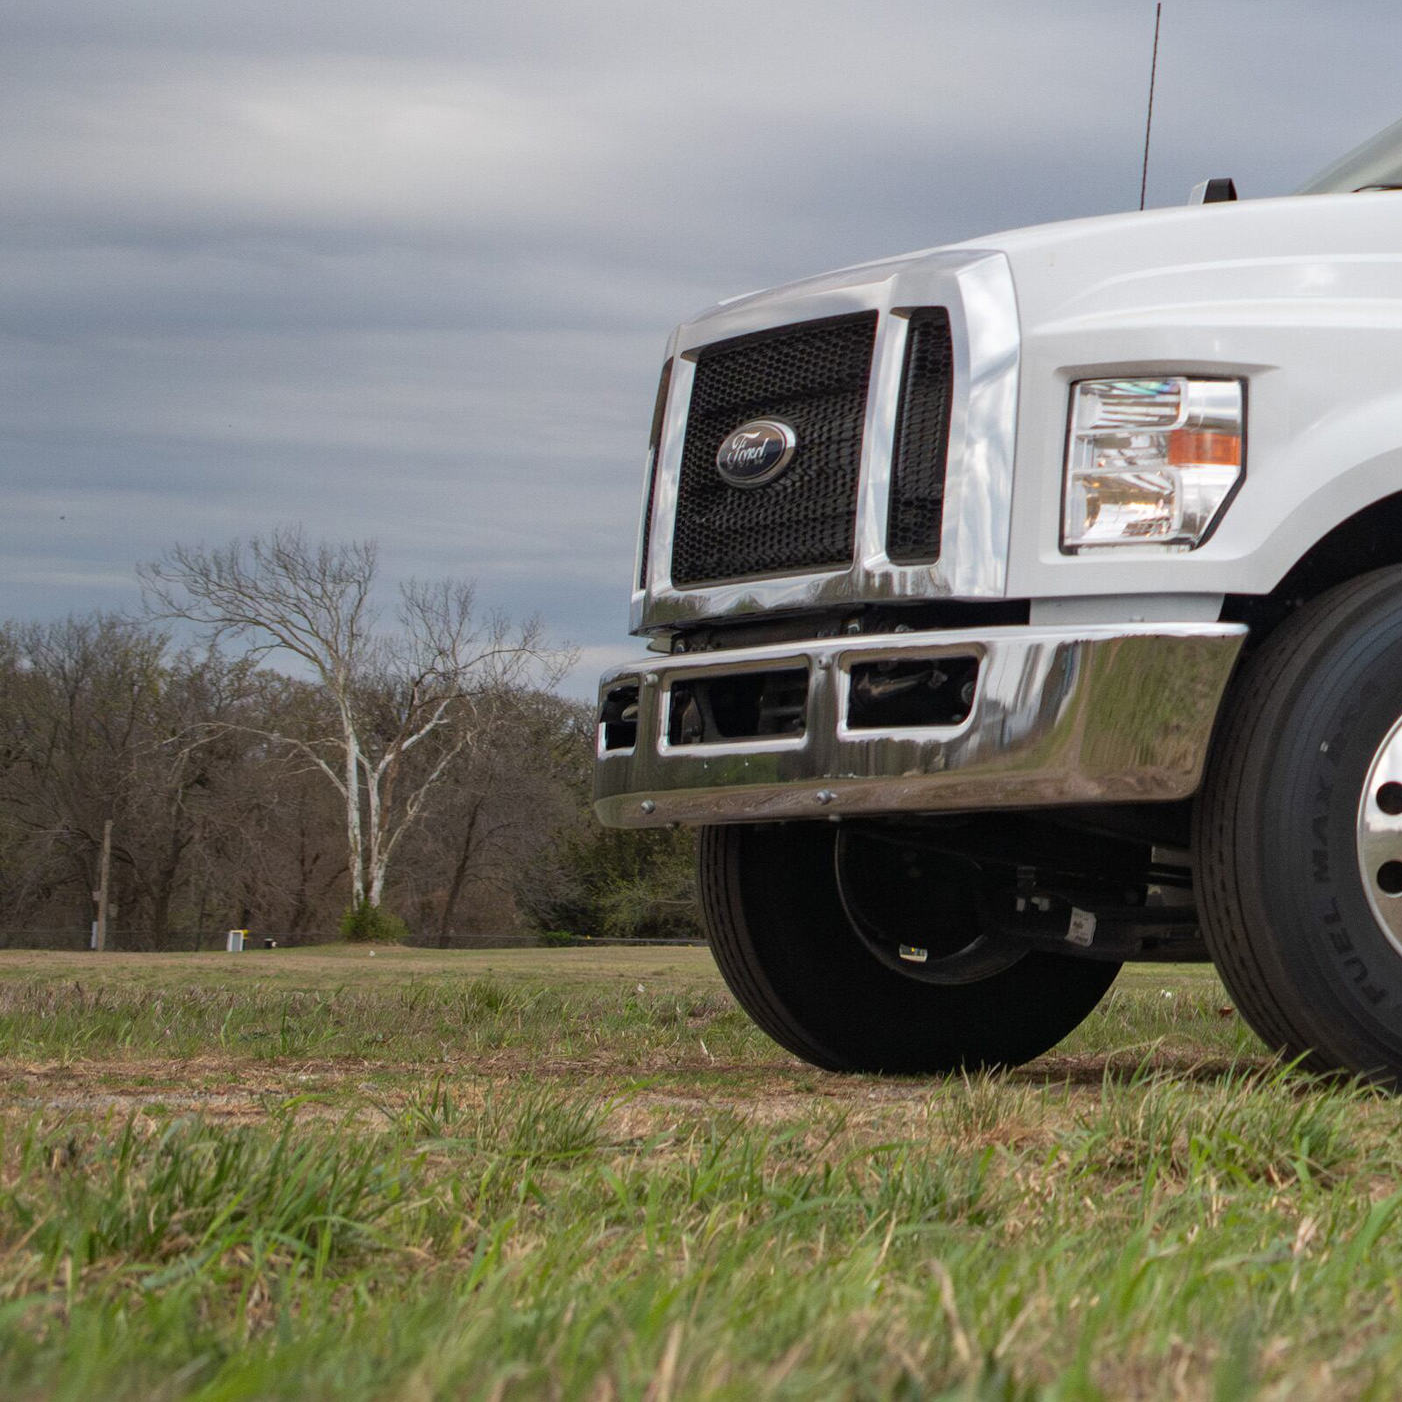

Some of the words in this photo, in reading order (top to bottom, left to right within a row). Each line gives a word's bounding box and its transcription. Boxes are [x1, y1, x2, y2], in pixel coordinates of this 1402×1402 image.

[727, 431, 769, 464] Ford
[1311, 775, 1334, 885] MAX
[1323, 896, 1388, 1005] FUEL
